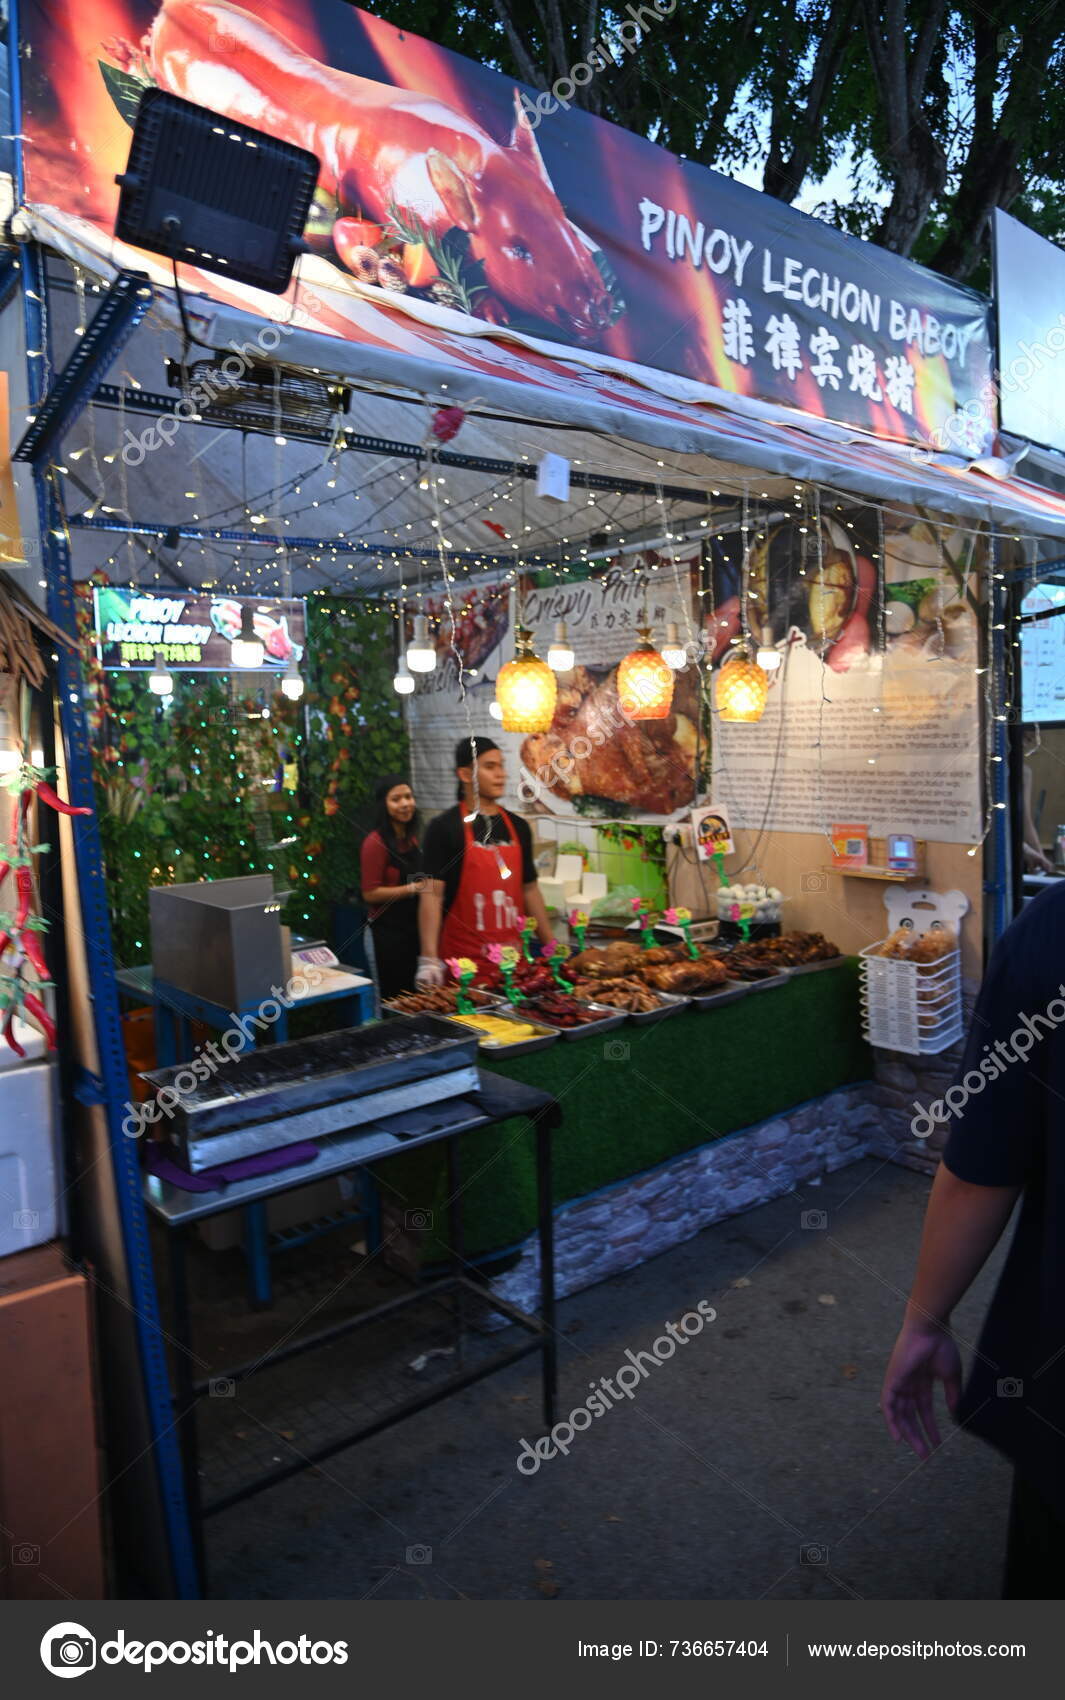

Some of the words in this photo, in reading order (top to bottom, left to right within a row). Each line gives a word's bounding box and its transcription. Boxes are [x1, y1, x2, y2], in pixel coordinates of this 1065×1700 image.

[639, 197, 754, 287] PINOY
[763, 249, 882, 333] LECHON
[890, 300, 972, 367] BABOY
[721, 298, 916, 415] 菲律宾烧猪
[130, 597, 186, 624] PINOY
[521, 586, 592, 626] Crispy
